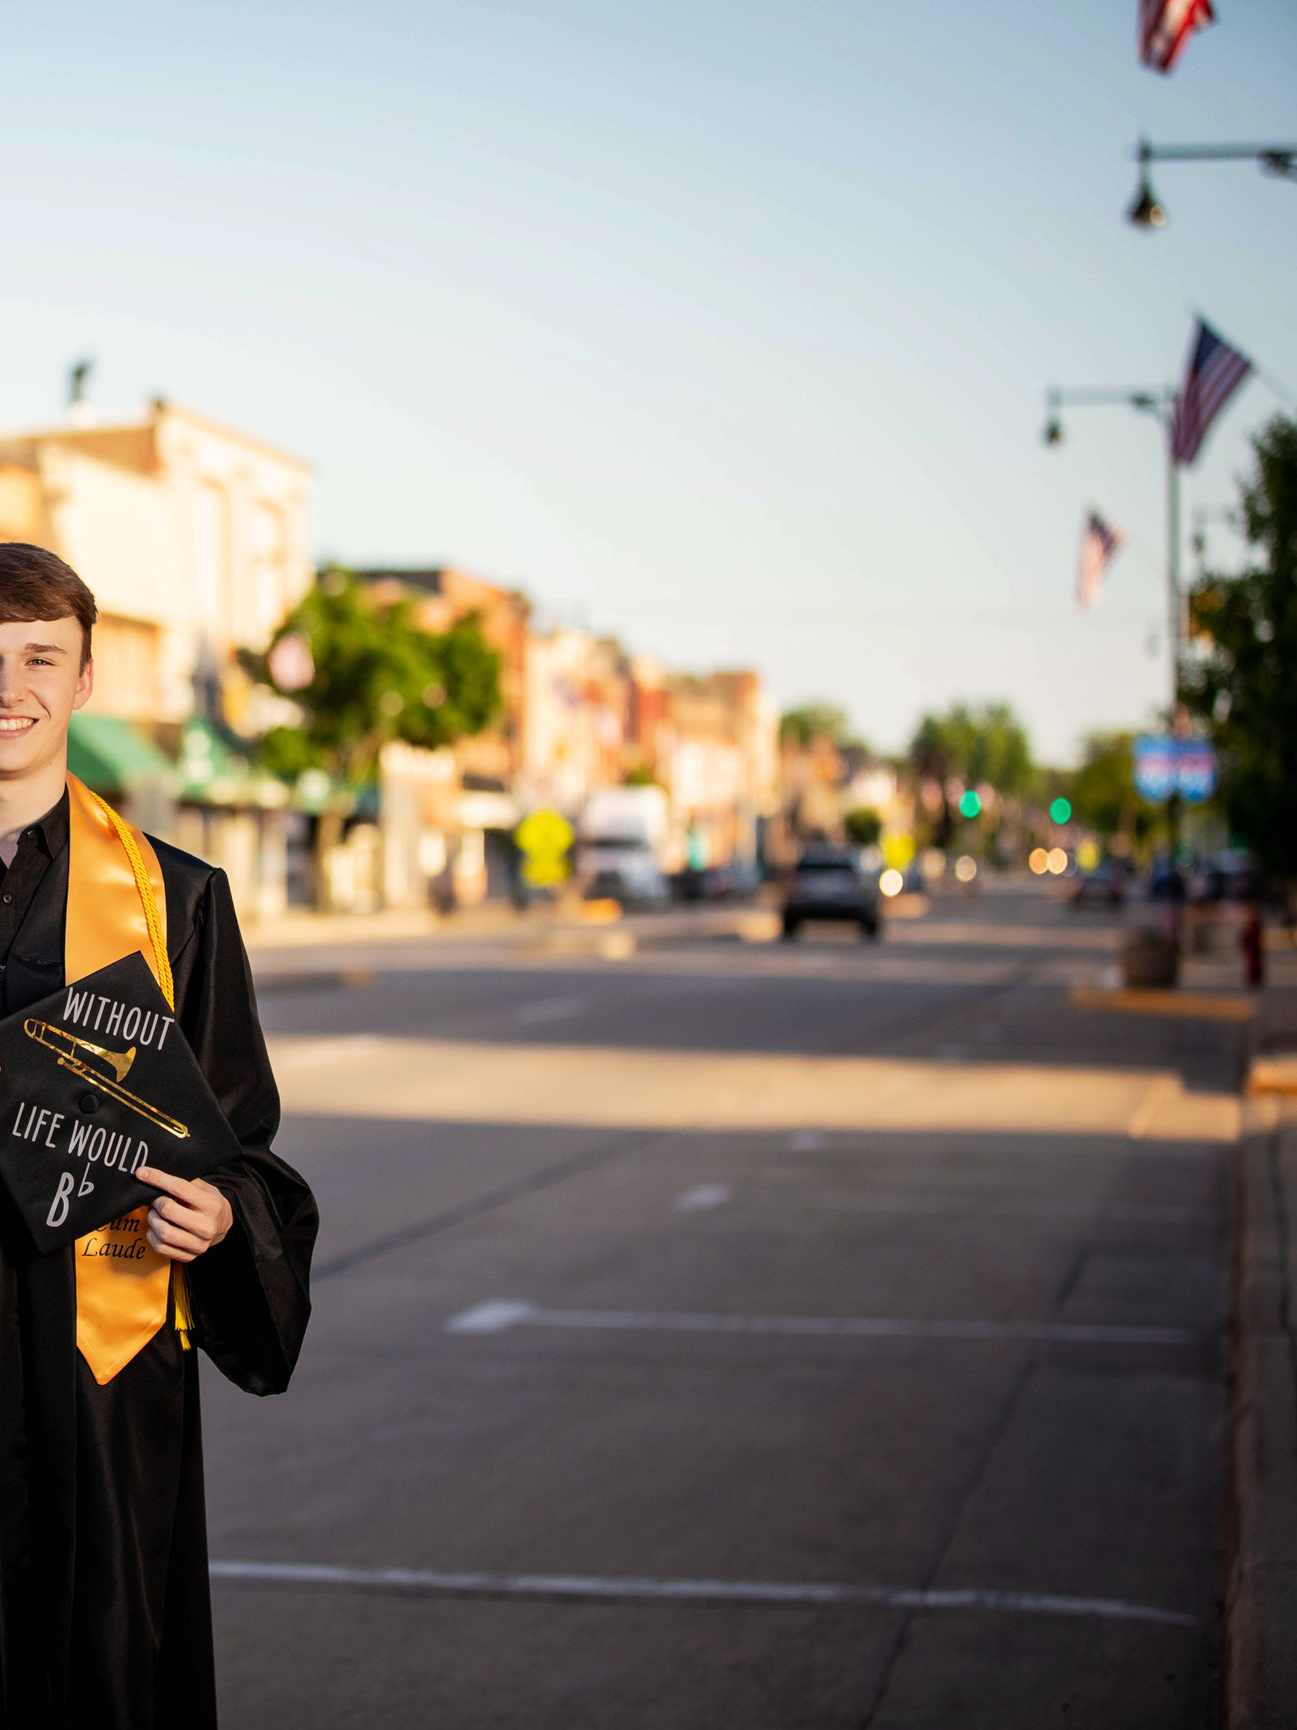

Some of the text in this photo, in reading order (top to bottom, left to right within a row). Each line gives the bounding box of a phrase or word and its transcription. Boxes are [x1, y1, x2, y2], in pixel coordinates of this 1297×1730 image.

[62, 986, 175, 1050] WITHOUT
[12, 1101, 149, 1175] LIFE WOULD
[81, 1237, 147, 1260] Laude
